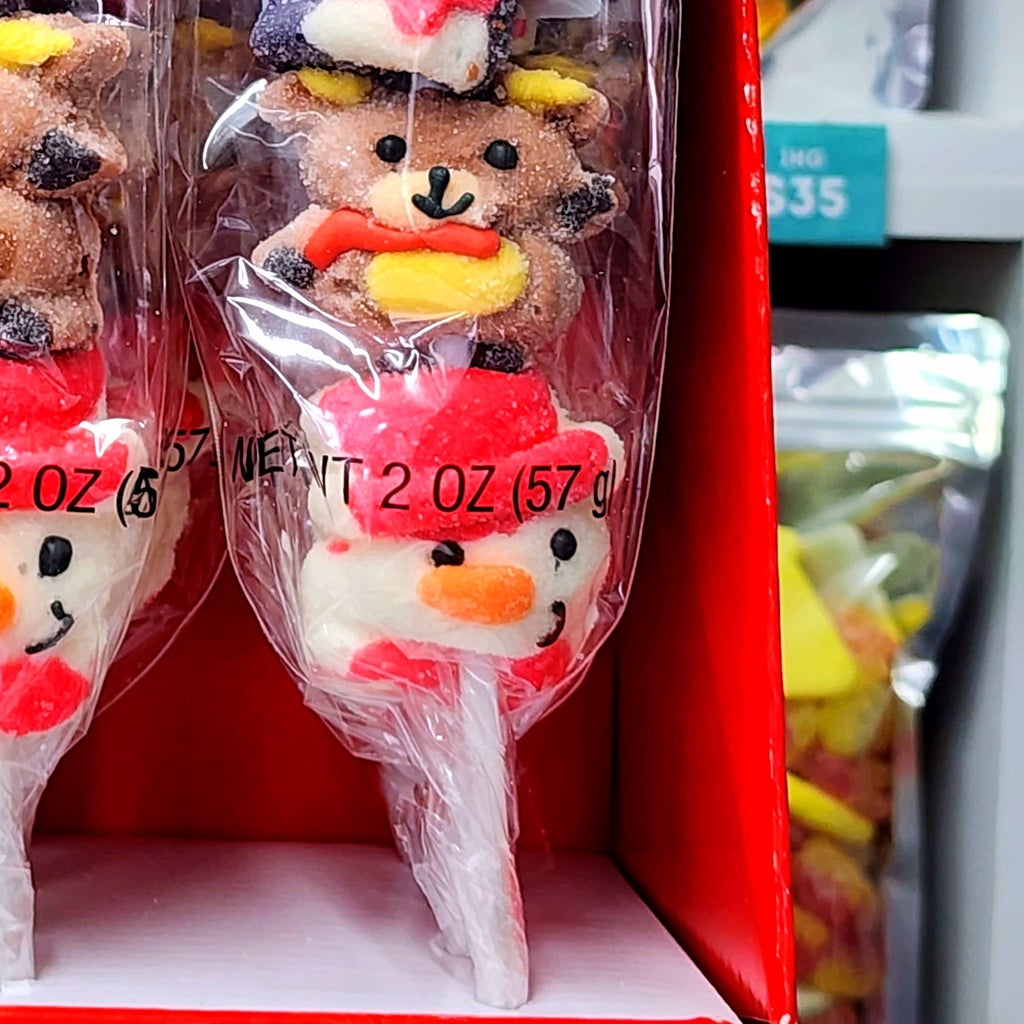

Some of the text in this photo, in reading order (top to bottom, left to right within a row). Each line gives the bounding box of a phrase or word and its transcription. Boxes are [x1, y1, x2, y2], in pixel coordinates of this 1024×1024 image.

[33, 464, 102, 514] OZ
[232, 429, 297, 484] NET
[381, 462, 413, 511] 2
[433, 464, 496, 513] OZ
[512, 464, 582, 523] (57
